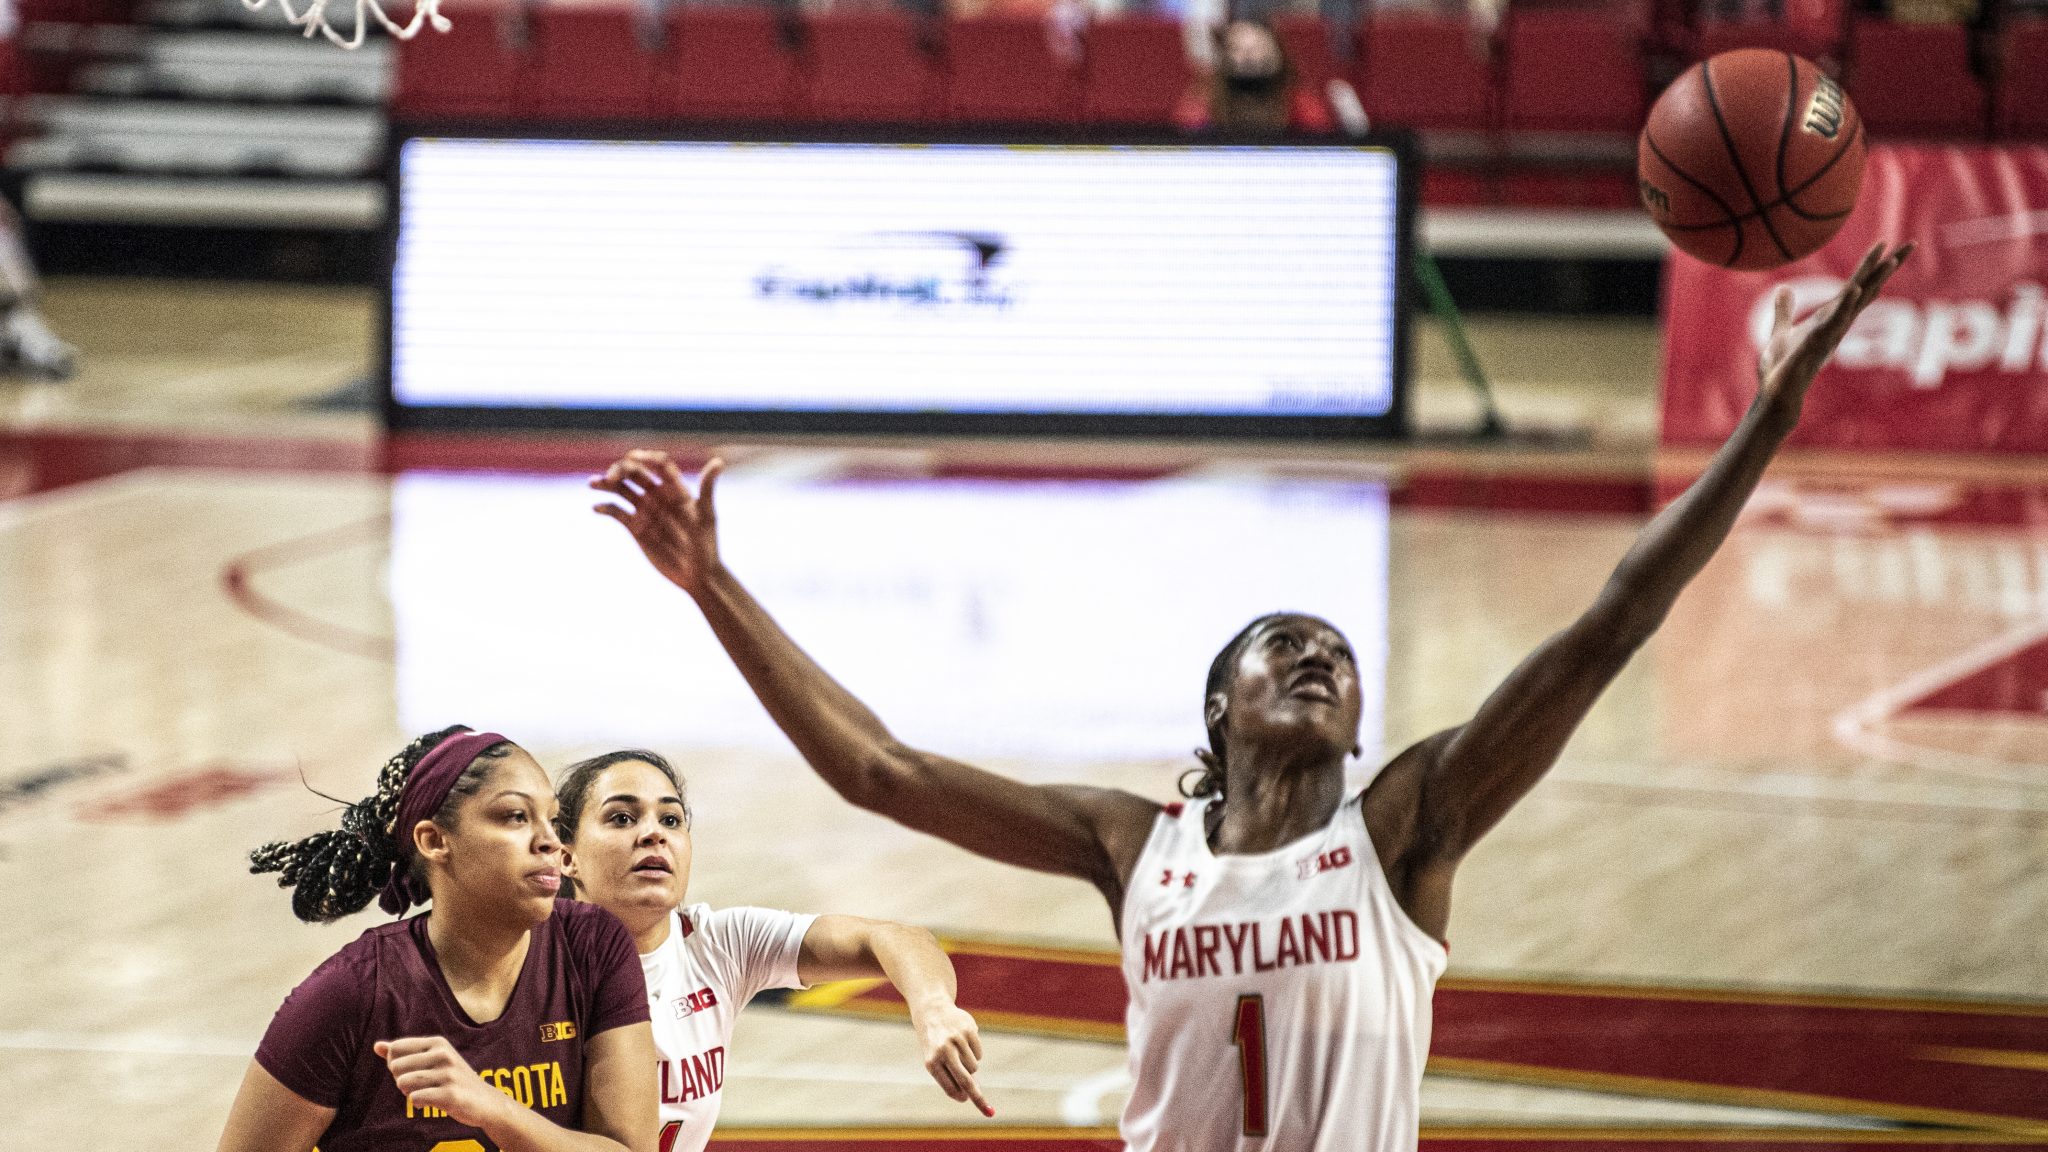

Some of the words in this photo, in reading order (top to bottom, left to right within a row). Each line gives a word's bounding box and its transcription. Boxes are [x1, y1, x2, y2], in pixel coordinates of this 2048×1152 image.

[1751, 275, 2048, 388] Capi
[1142, 909, 1361, 984] MARYLAND
[657, 1046, 724, 1104] LAND
[1232, 993, 1268, 1138] 1
